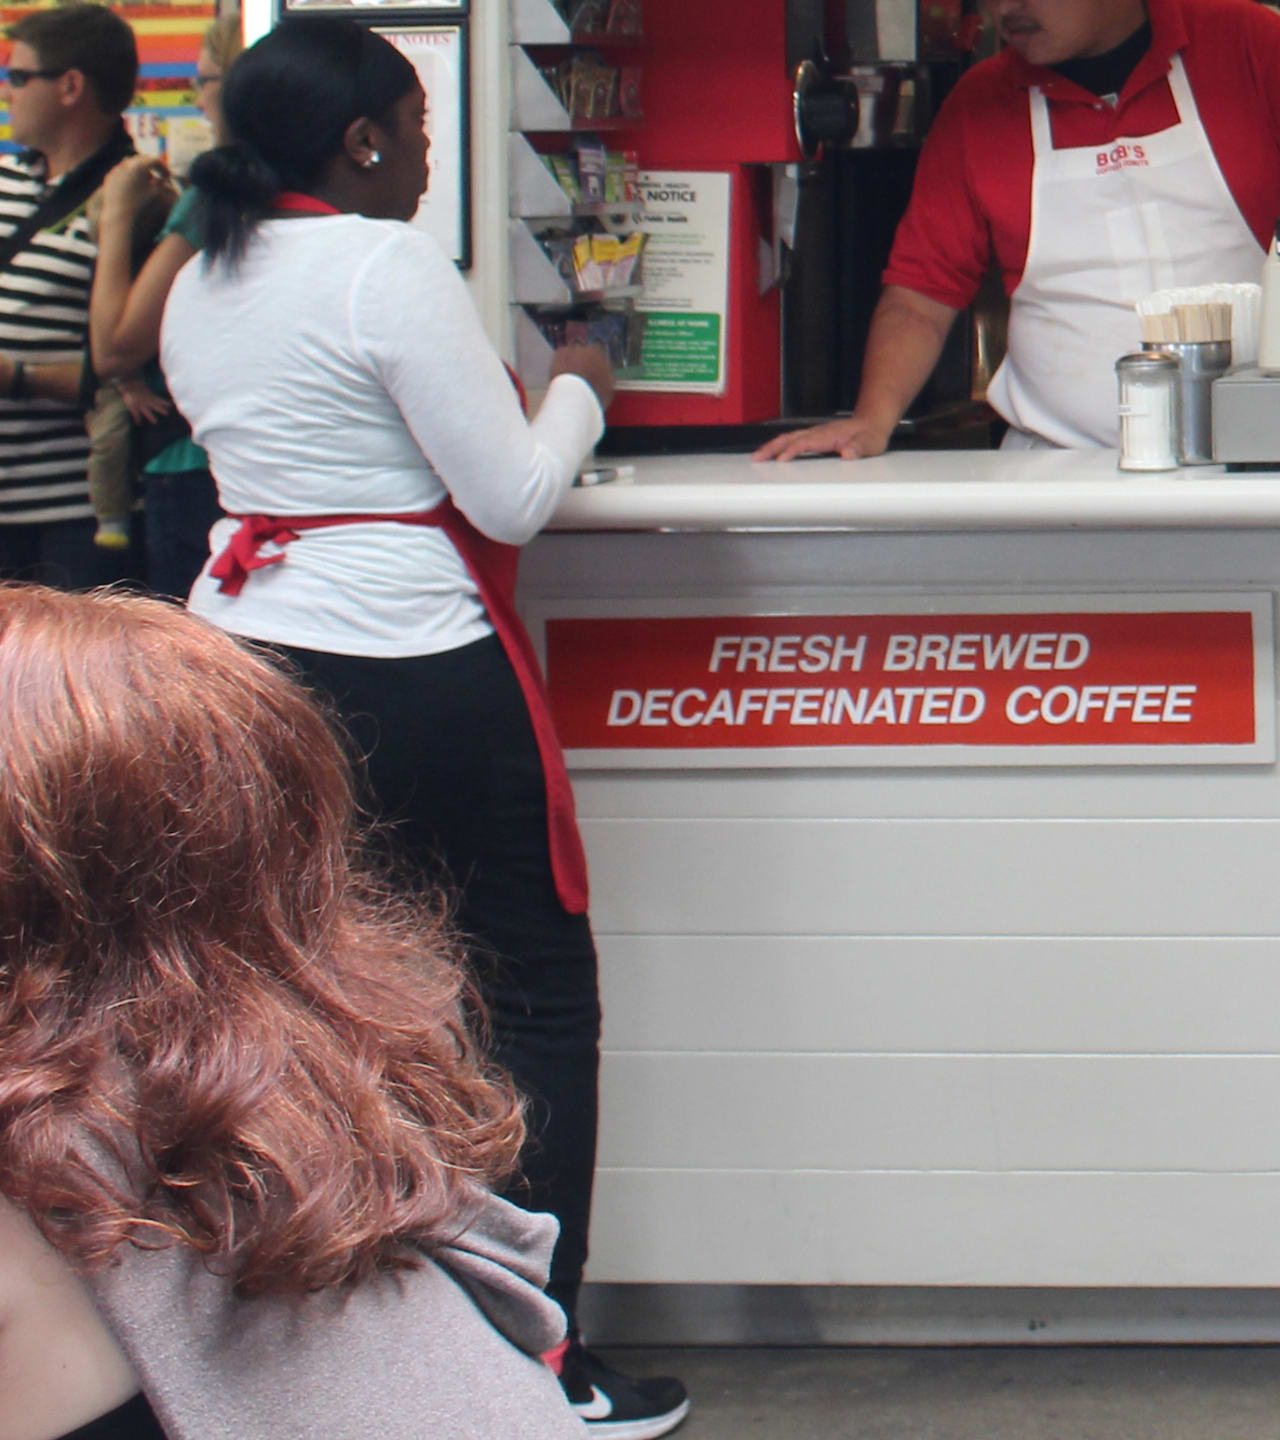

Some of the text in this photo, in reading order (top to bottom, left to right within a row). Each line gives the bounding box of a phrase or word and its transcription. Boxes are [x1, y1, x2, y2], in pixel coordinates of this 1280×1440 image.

[647, 191, 696, 202] NOTICE
[707, 632, 1090, 674] FRESH BREWED
[606, 684, 1197, 727] DECAFFEINATED COFFEE
